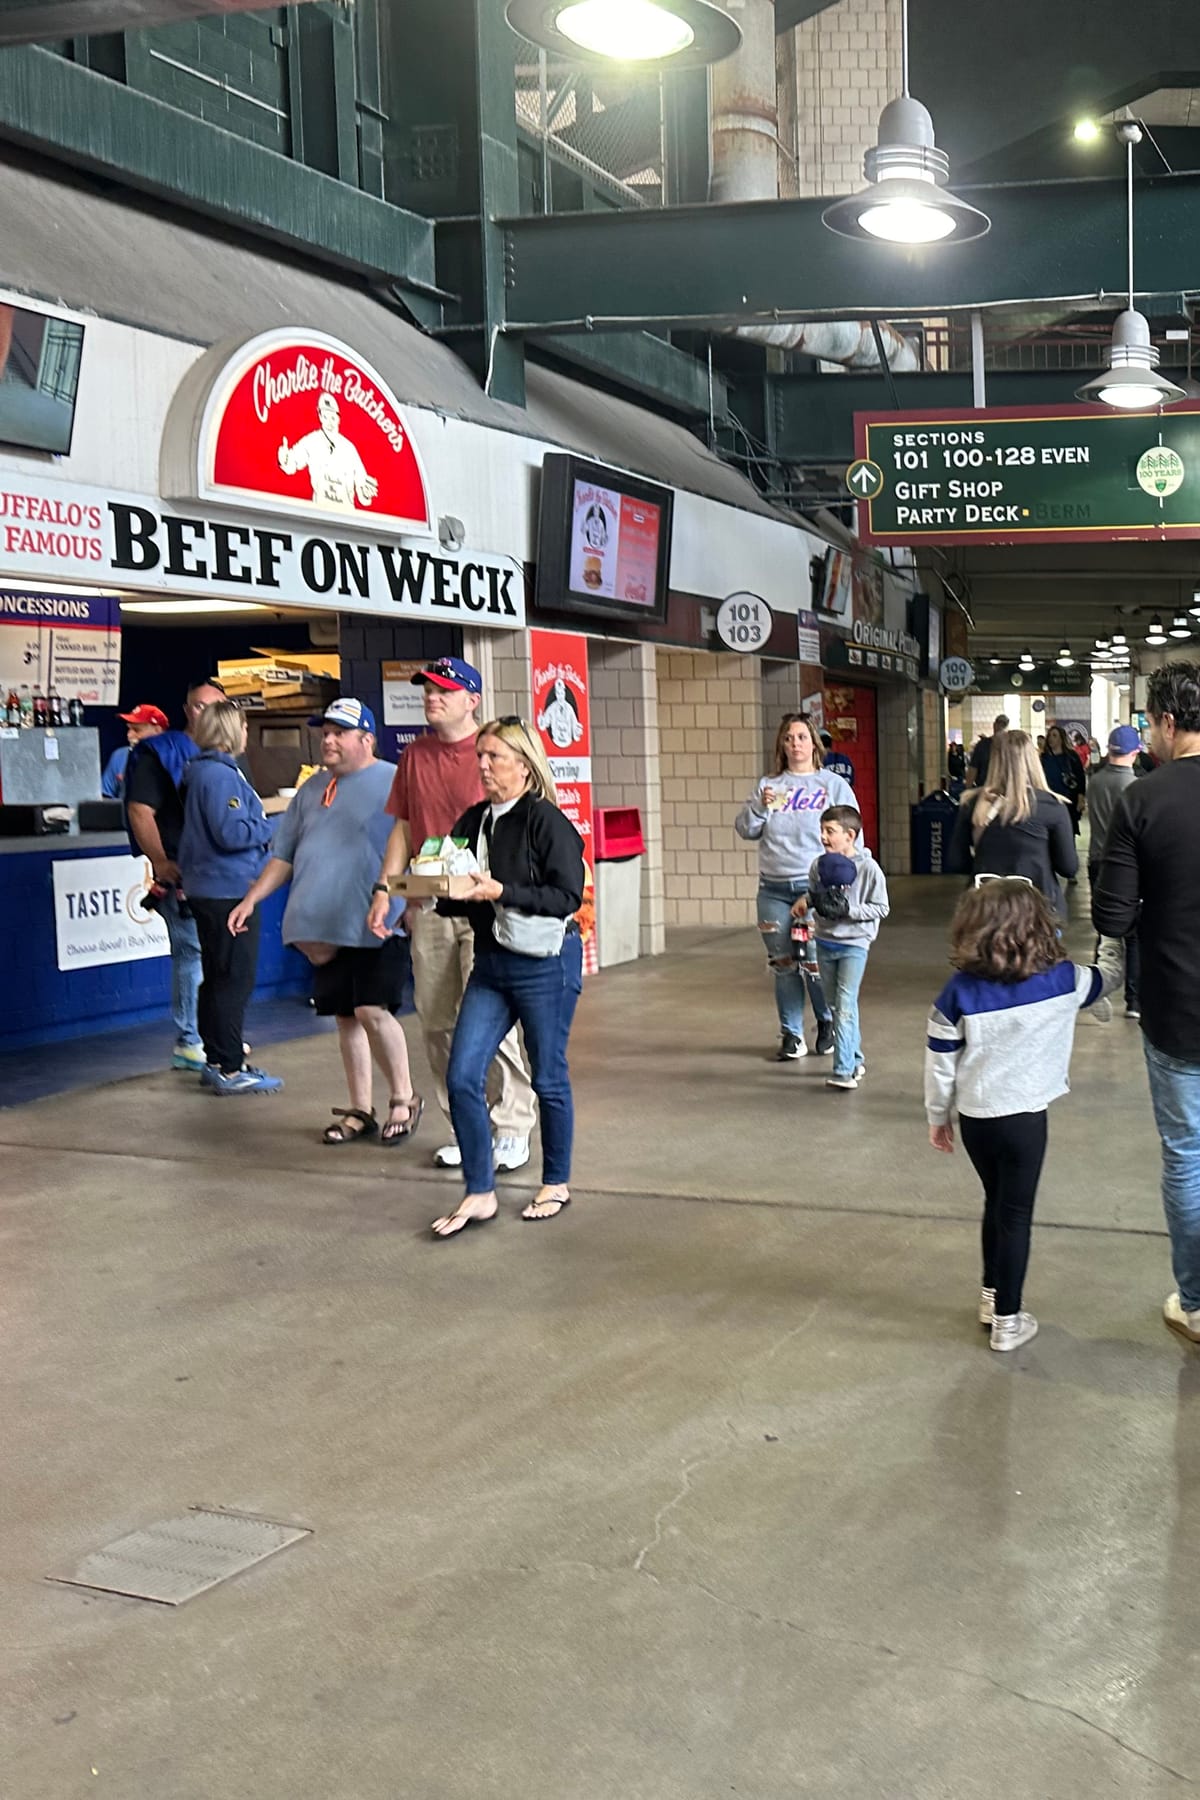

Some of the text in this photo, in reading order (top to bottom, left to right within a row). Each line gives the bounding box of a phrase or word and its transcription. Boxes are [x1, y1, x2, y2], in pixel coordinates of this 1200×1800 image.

[253, 354, 404, 453] Charlie the Butcher's
[893, 431, 985, 447] SECTIONS
[893, 446, 1090, 470] 101 100-128 EVEN
[895, 480, 1004, 500] GIFT SHOP
[897, 506, 957, 525] PARTY
[965, 504, 1020, 523] DECK
[4, 525, 103, 561] FAMOUS
[107, 501, 517, 617] BEEF ON WECK
[0, 595, 90, 618] NCESSIONS
[729, 603, 760, 622] 101
[728, 625, 762, 643] 103
[945, 663, 967, 674] 100
[946, 676, 966, 687] 101
[930, 820, 943, 873] RECYCLE
[65, 888, 122, 919] TASTE
